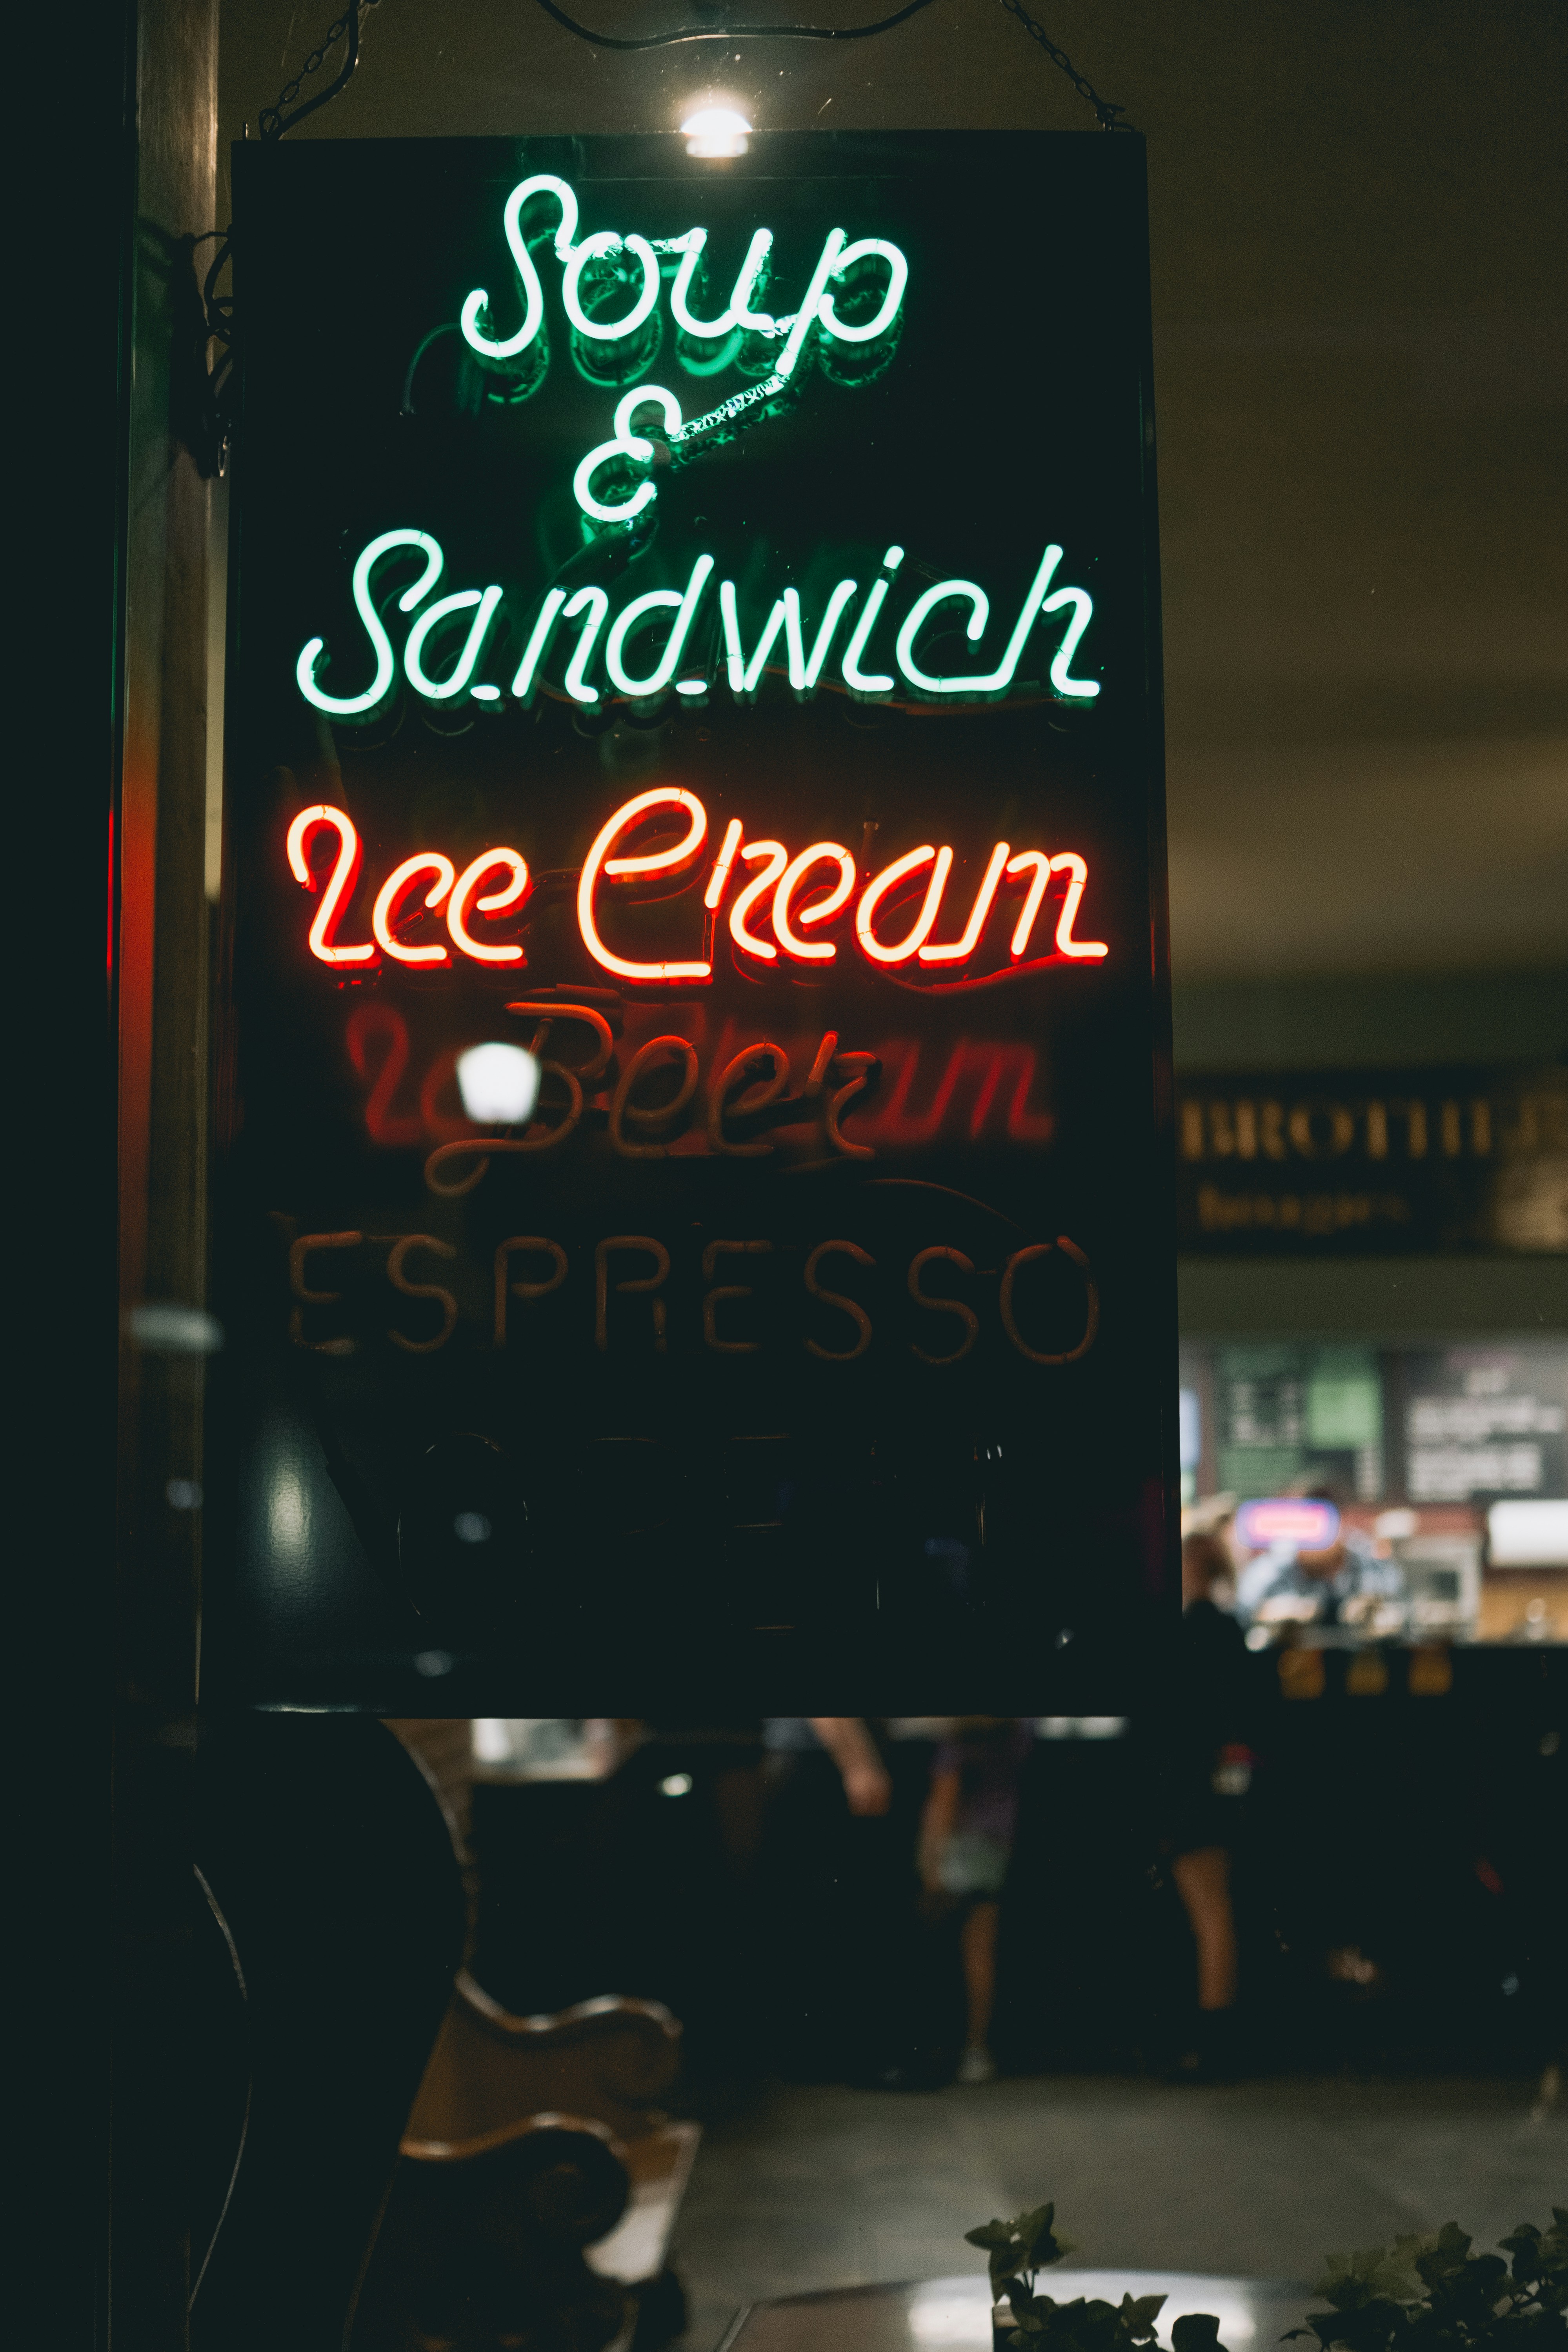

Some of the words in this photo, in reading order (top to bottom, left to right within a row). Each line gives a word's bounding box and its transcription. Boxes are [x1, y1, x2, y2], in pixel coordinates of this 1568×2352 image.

[460, 173, 909, 377] Soup
[295, 528, 1103, 716] Sandwich
[285, 802, 530, 966] Ice
[576, 785, 1111, 981] Cream
[424, 999, 882, 1196] Beer
[288, 1233, 1101, 1365] ESPRESSO
